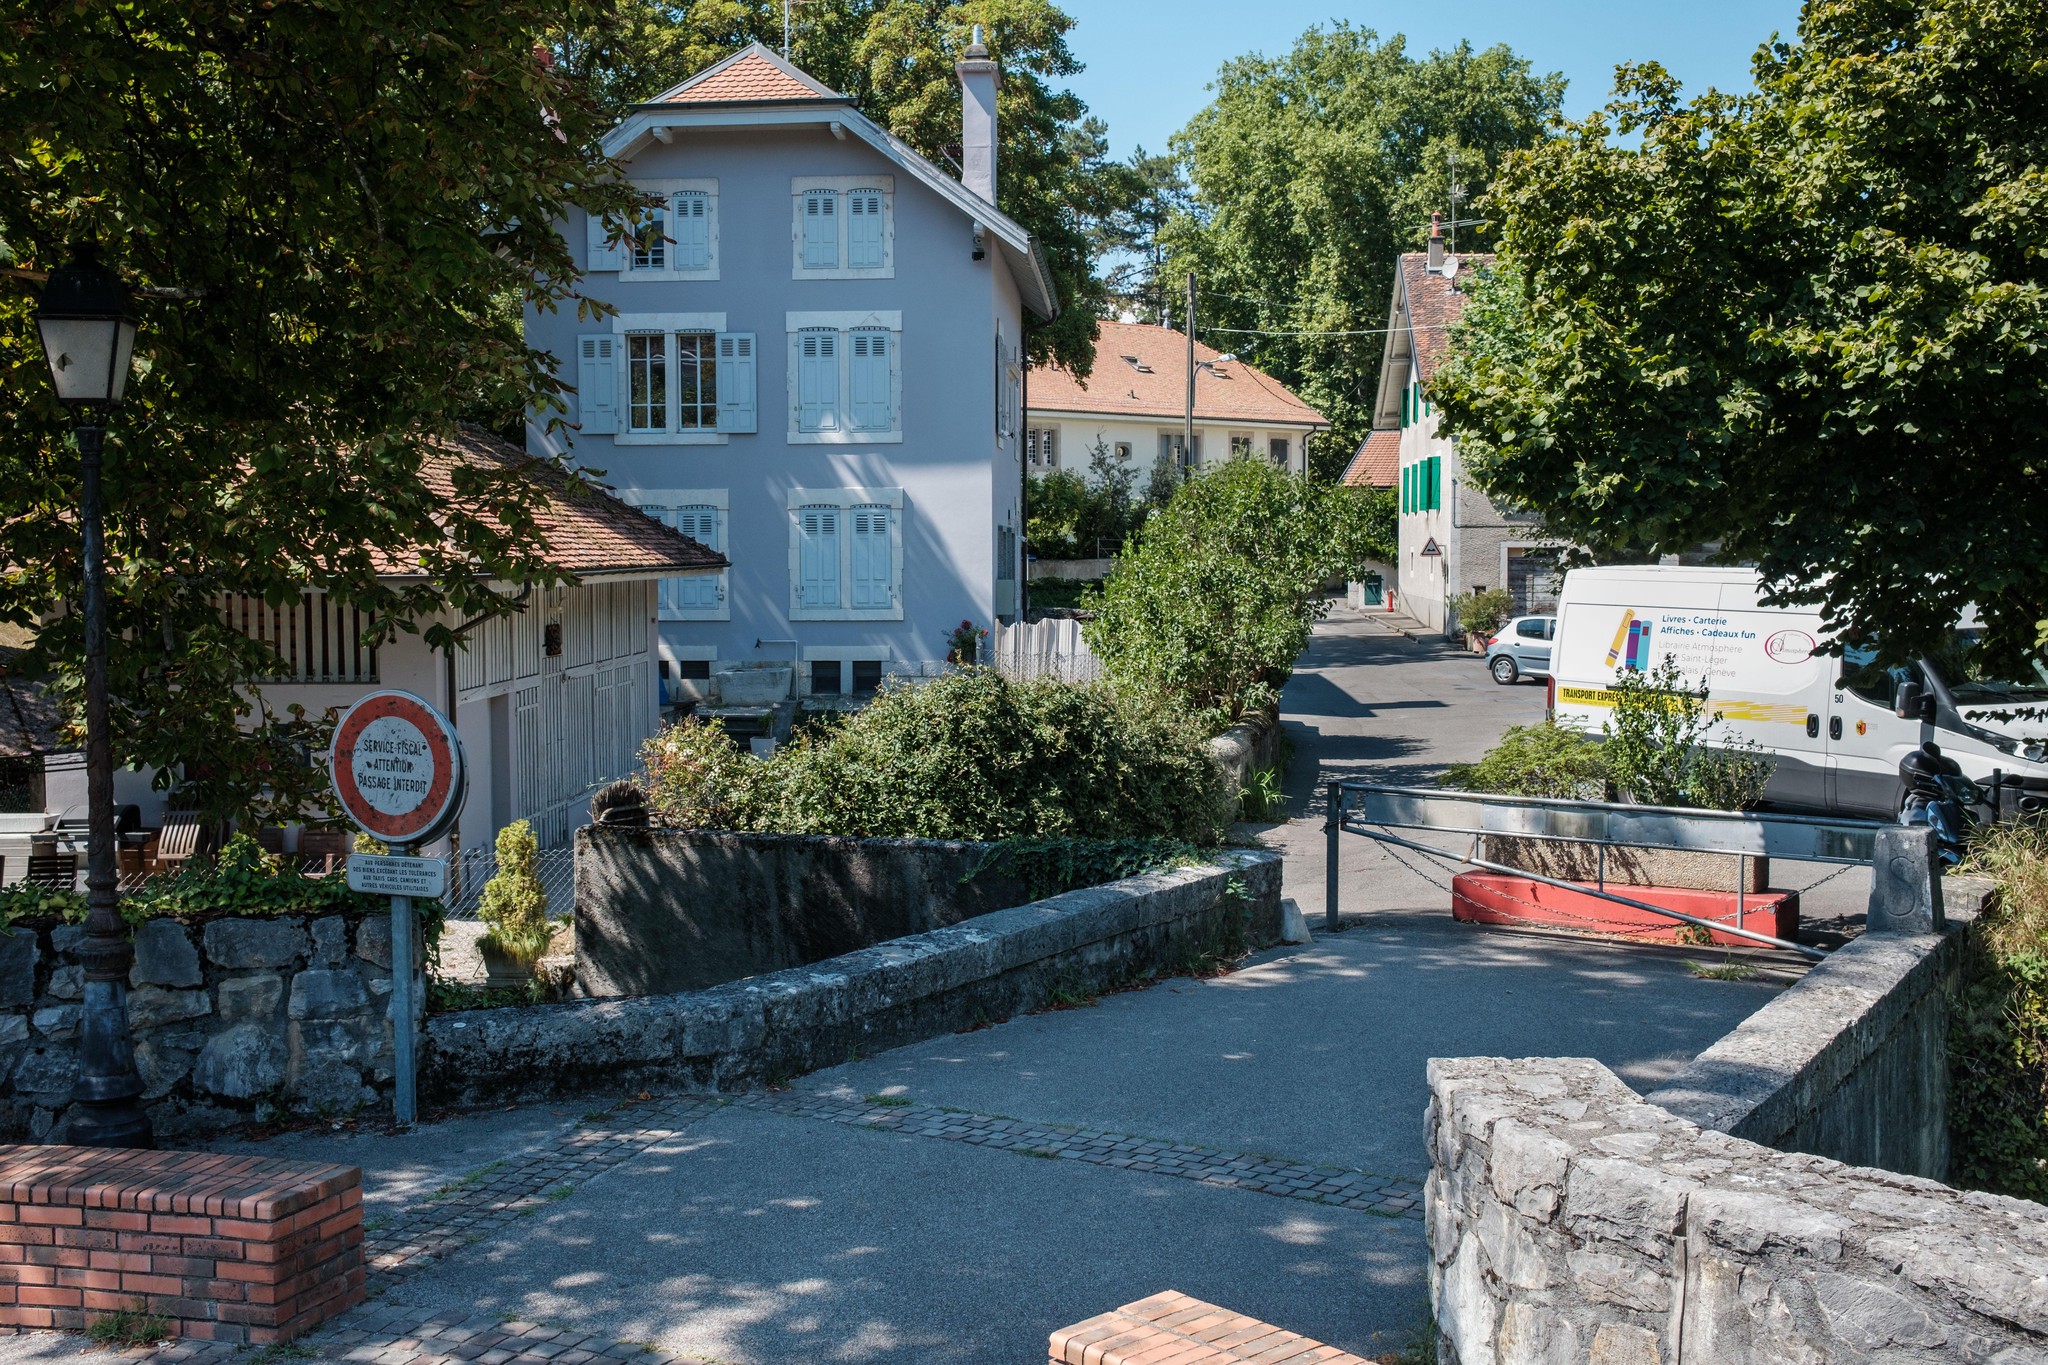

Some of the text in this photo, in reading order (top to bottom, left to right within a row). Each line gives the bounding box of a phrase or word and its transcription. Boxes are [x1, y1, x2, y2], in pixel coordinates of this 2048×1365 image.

[1661, 614, 1728, 626] Livres Carterie
[1660, 625, 1757, 640] Affiches Cadeaux fun
[1658, 640, 1743, 654] Librairie Atmosphère
[1705, 666, 1737, 678] Genève
[1563, 687, 1596, 700] TRANSPORT
[1835, 694, 1844, 704] 50
[374, 756, 413, 774] ATTENTION
[358, 773, 427, 794] PASSAGE INTERDIT
